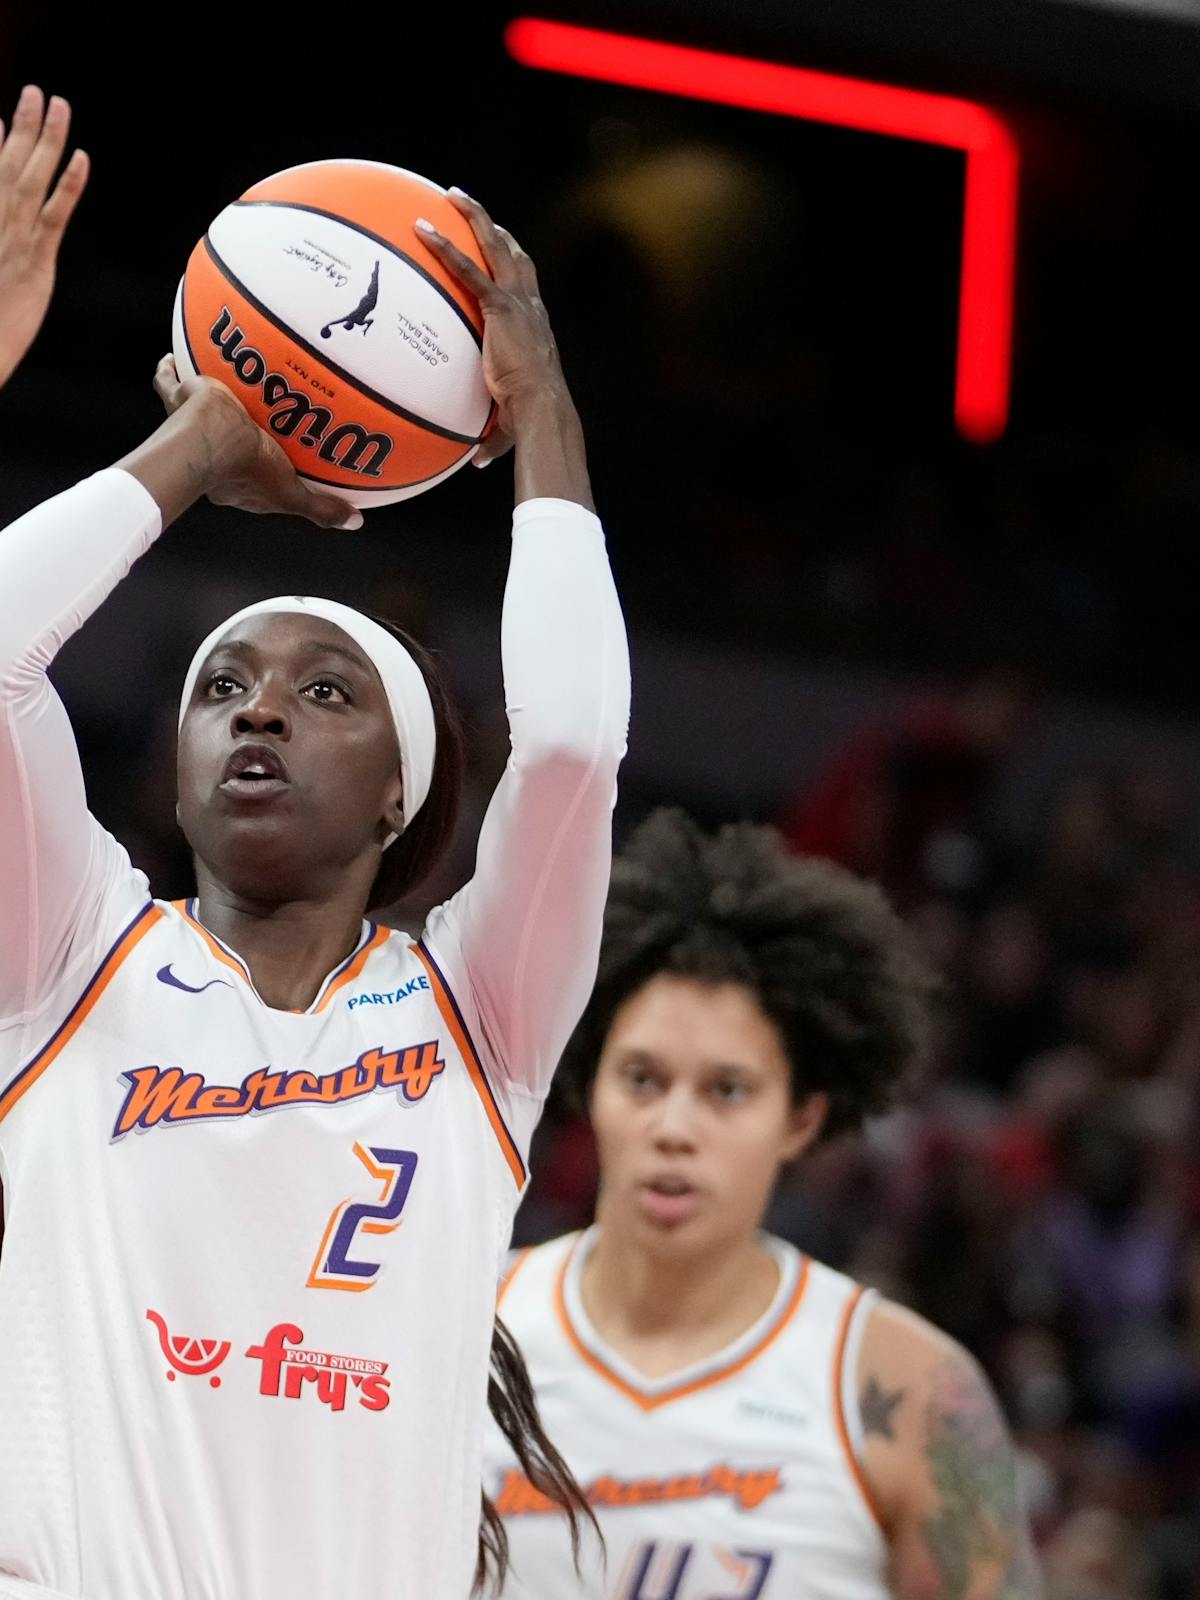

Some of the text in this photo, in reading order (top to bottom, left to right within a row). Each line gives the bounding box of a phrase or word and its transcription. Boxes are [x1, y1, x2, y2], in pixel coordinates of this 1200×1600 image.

[397, 312, 449, 363] GAME BALL
[397, 326, 438, 367] OFFICIAL
[209, 304, 394, 477] Wilson
[285, 360, 335, 398] EVO NXT
[347, 975, 431, 1010] PARTAKE
[109, 1039, 445, 1145] Mercury
[305, 1141, 418, 1293] 2
[244, 1322, 391, 1412] fry's
[284, 1350, 384, 1374] FOOD STORES
